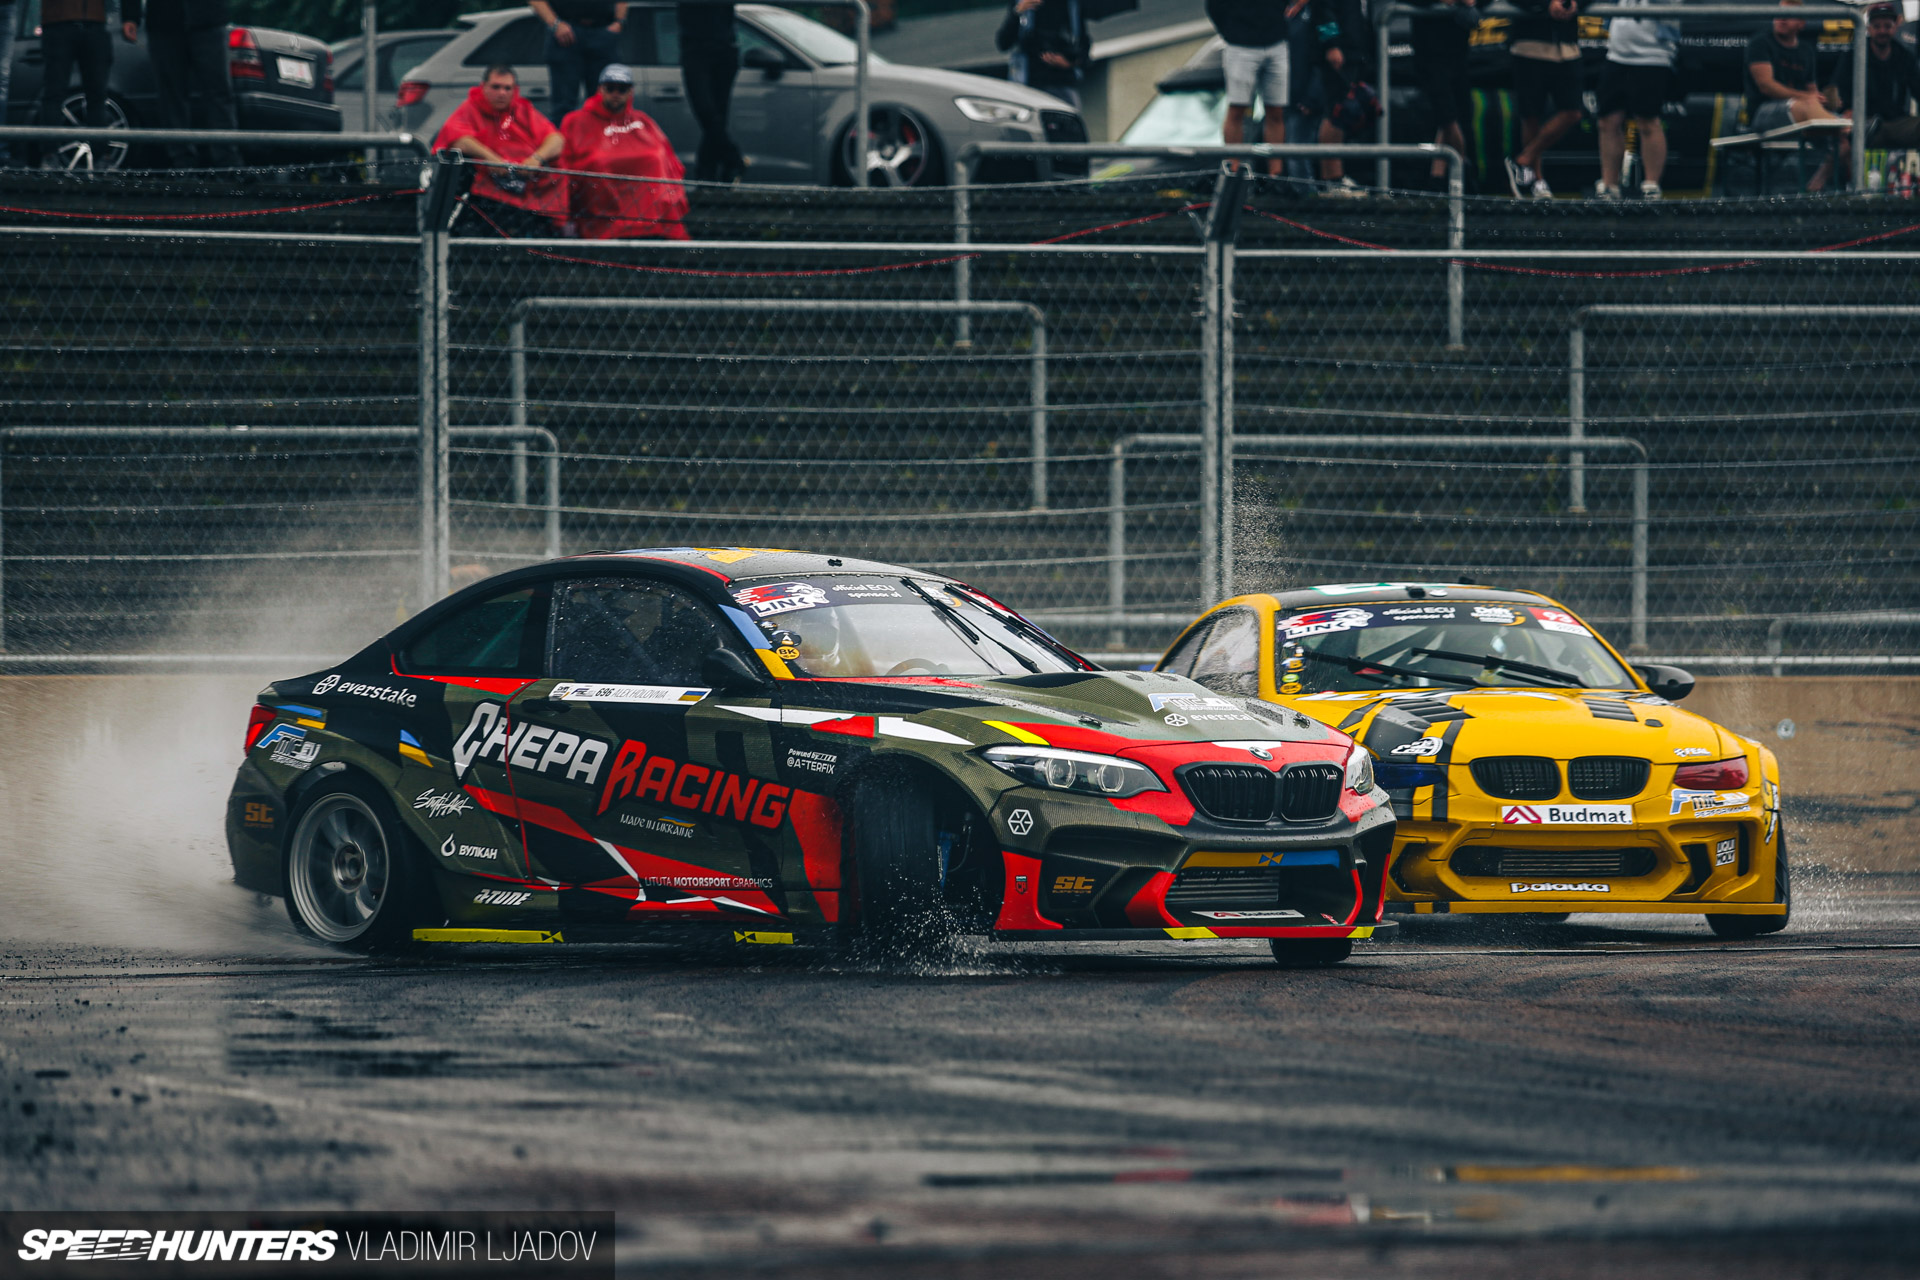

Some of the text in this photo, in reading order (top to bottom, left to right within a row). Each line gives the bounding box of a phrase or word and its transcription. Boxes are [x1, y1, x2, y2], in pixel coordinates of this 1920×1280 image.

[869, 584, 895, 592] ECU
[754, 596, 811, 614] LINK
[1424, 606, 1456, 614] ECU
[337, 682, 417, 708] everstake
[595, 687, 611, 697] 696
[613, 688, 630, 698] ALEX
[596, 739, 790, 829] RACING
[620, 813, 646, 829] MADE
[459, 845, 498, 859] ВУЛКАН
[674, 877, 731, 888] MOTORSPORT
[732, 878, 773, 888] GRAPHICS
